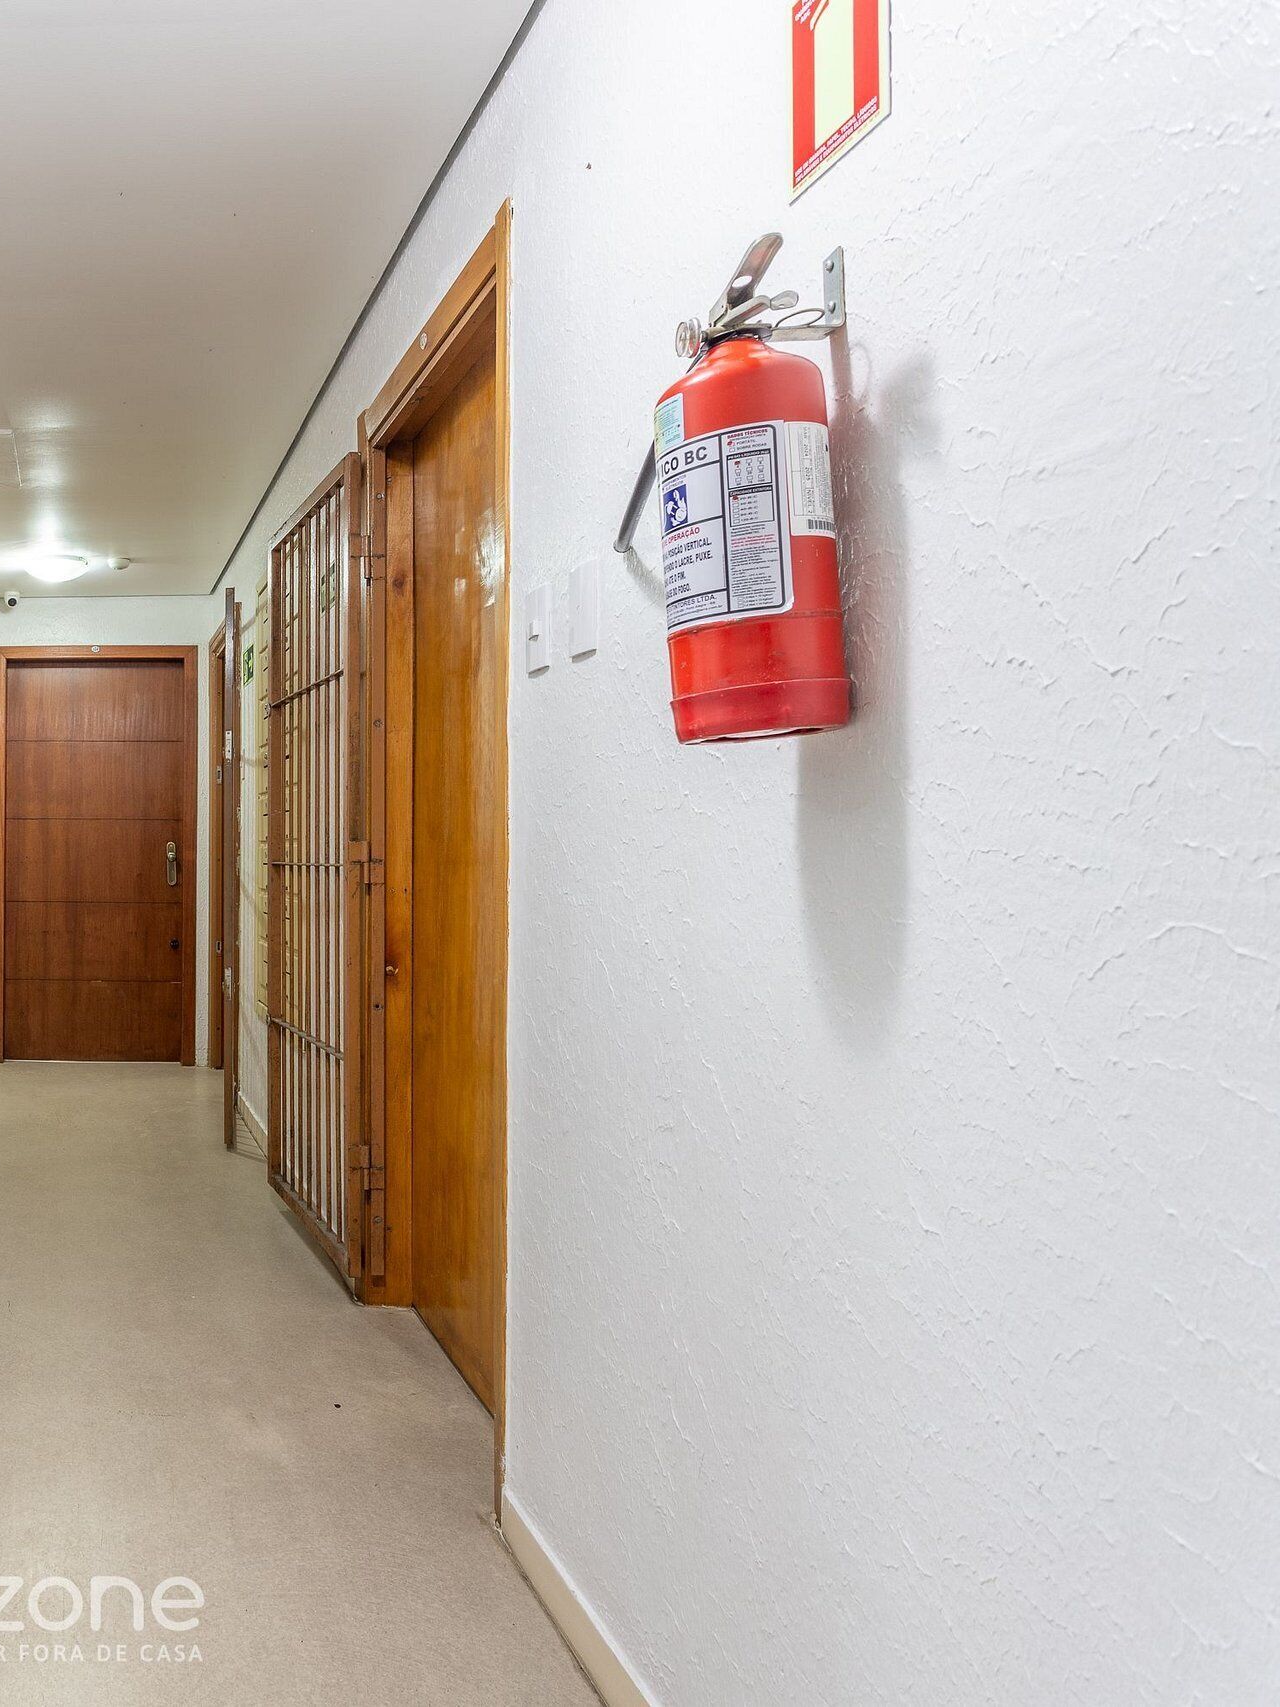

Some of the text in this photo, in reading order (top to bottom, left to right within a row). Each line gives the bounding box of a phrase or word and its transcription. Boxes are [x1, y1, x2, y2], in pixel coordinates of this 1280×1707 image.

[684, 446, 708, 466] BC
[668, 526, 700, 544] OPERAÇÃO
[684, 537, 712, 553] VERTICAL.
[696, 550, 713, 563] PUXE.
[697, 594, 717, 604] LTDA.
